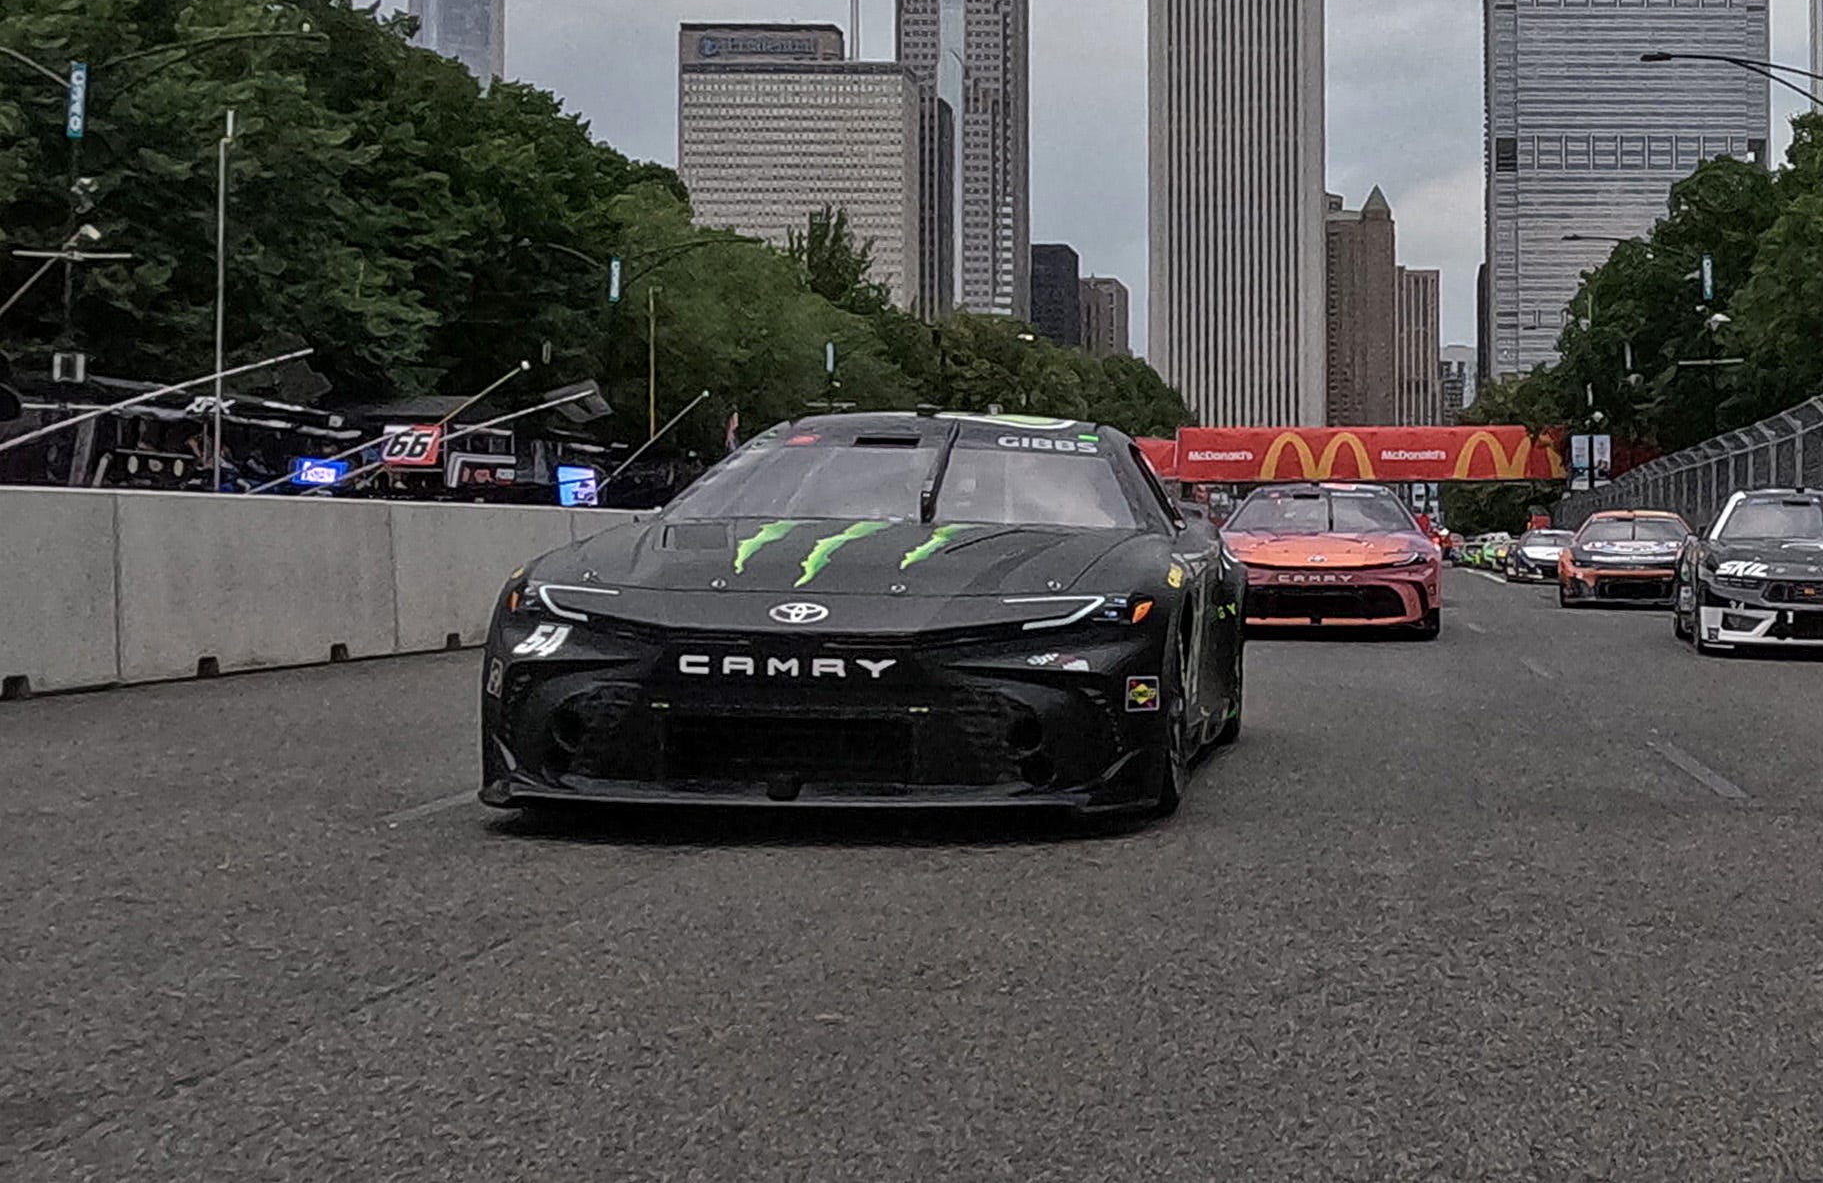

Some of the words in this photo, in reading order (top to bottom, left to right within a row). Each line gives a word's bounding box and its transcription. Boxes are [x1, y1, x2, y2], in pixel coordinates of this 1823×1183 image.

[390, 428, 432, 458] 66
[997, 436, 1098, 454] GIBBS
[1187, 450, 1254, 462] McDonald's
[1380, 450, 1447, 462] McDonald's
[1715, 560, 1769, 578] SKIL
[1277, 574, 1353, 584] CAMRY
[511, 623, 573, 658] 54
[678, 654, 897, 679] CAMRY
